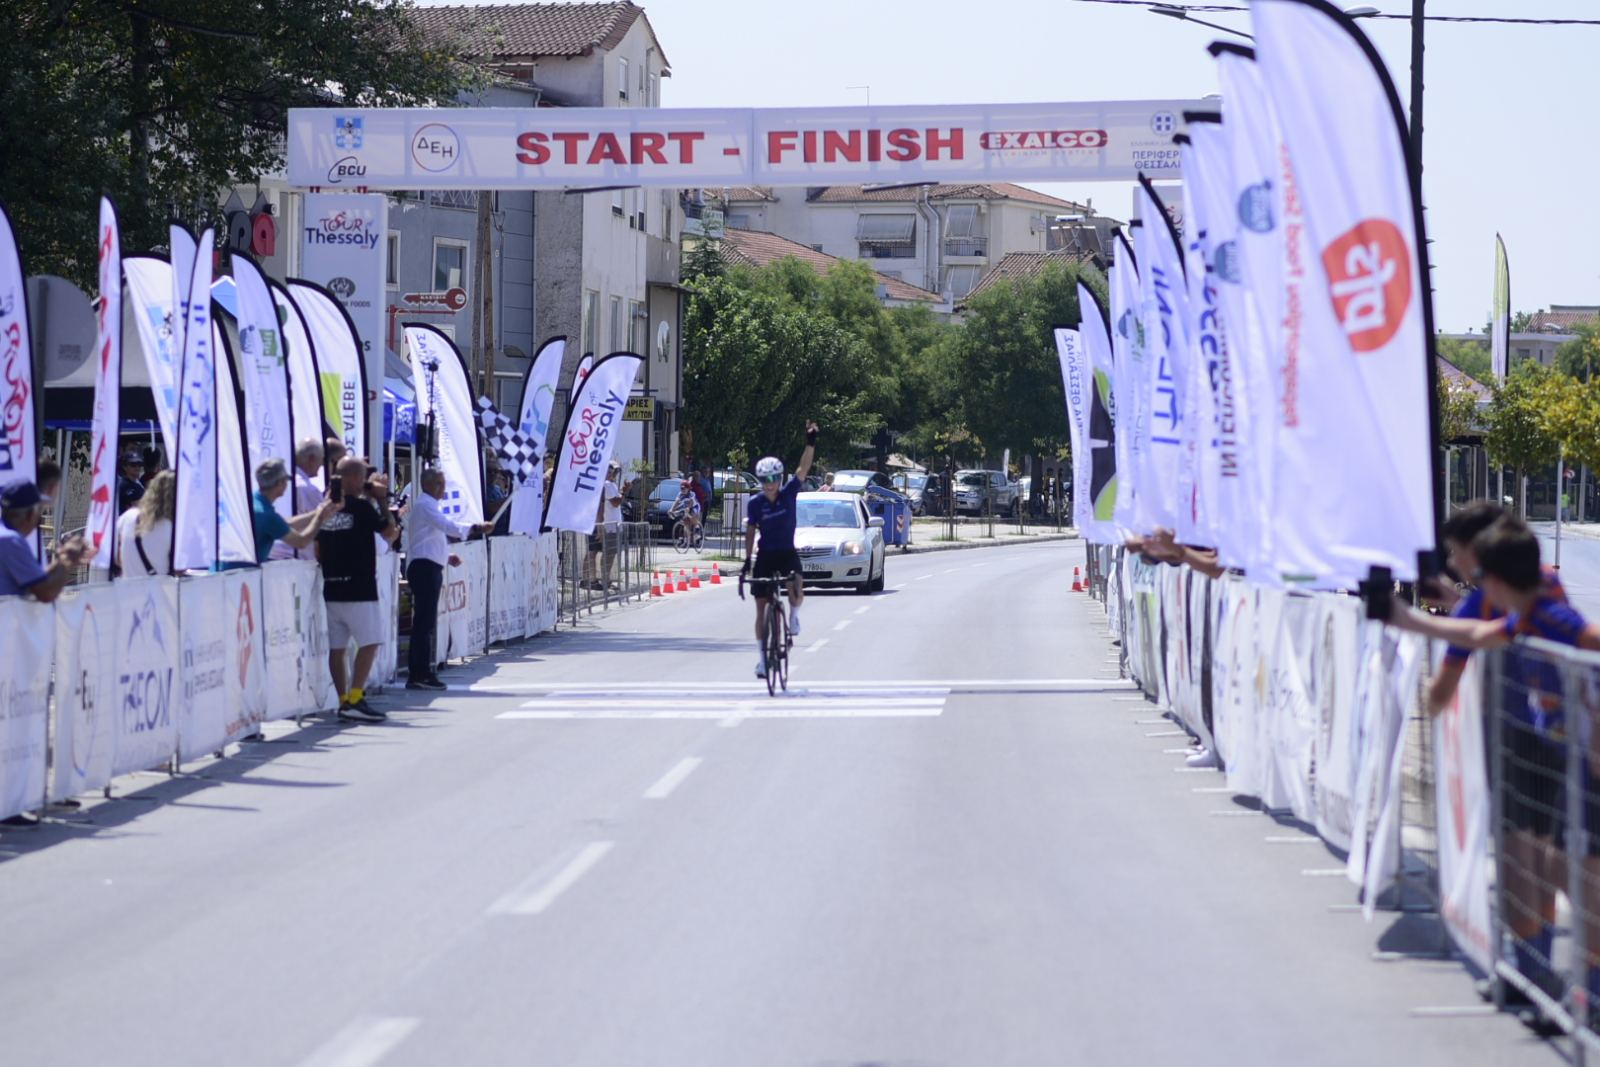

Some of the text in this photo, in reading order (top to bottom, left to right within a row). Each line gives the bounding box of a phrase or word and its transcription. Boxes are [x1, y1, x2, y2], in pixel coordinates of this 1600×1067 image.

[416, 136, 453, 159] ΔΕΗ
[515, 131, 705, 165] START
[767, 127, 964, 164] FINISH
[988, 131, 1100, 150] EXALCO
[1132, 149, 1183, 159] ΠΕΡΙΦΕΡ
[337, 165, 367, 176] BCU
[1134, 160, 1182, 169] ΘΕΣΣΑΛΙ
[320, 213, 362, 233] TOUR
[305, 227, 379, 249] Thessaly
[350, 300, 371, 308] FOODS
[625, 398, 649, 408] ΑΡΙΕΣ
[568, 407, 600, 470] TOUR
[574, 389, 624, 493] Thessaly
